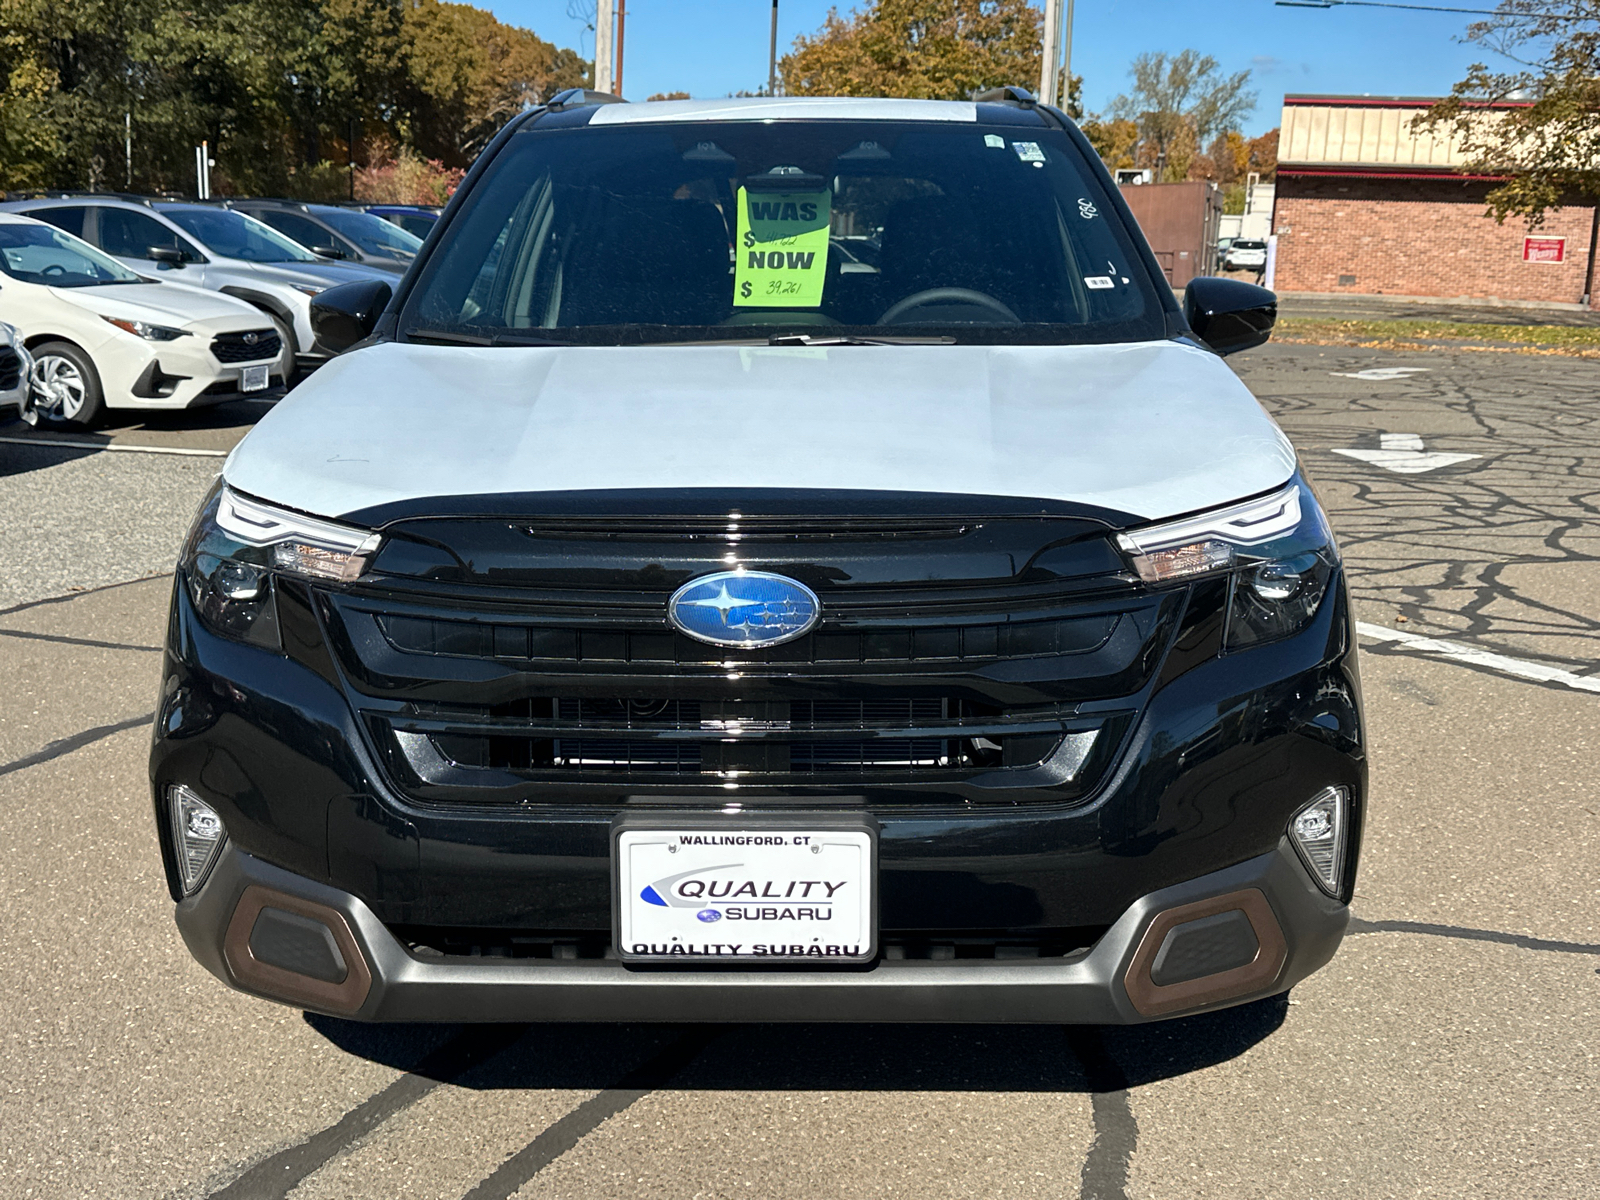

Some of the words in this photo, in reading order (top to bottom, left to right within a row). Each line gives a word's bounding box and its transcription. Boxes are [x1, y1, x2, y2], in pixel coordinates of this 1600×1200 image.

[751, 202, 817, 221] WAS
[743, 230, 756, 249] $
[748, 251, 815, 269] NOW
[740, 280, 753, 299] $
[766, 280, 802, 295] 39,261
[679, 835, 788, 846] WALLINGFORD,
[793, 835, 811, 846] CT
[677, 880, 847, 899] QUALITY
[725, 907, 832, 921] SUBARU
[632, 943, 743, 956] QUALITY
[752, 944, 860, 957] SUBARU
